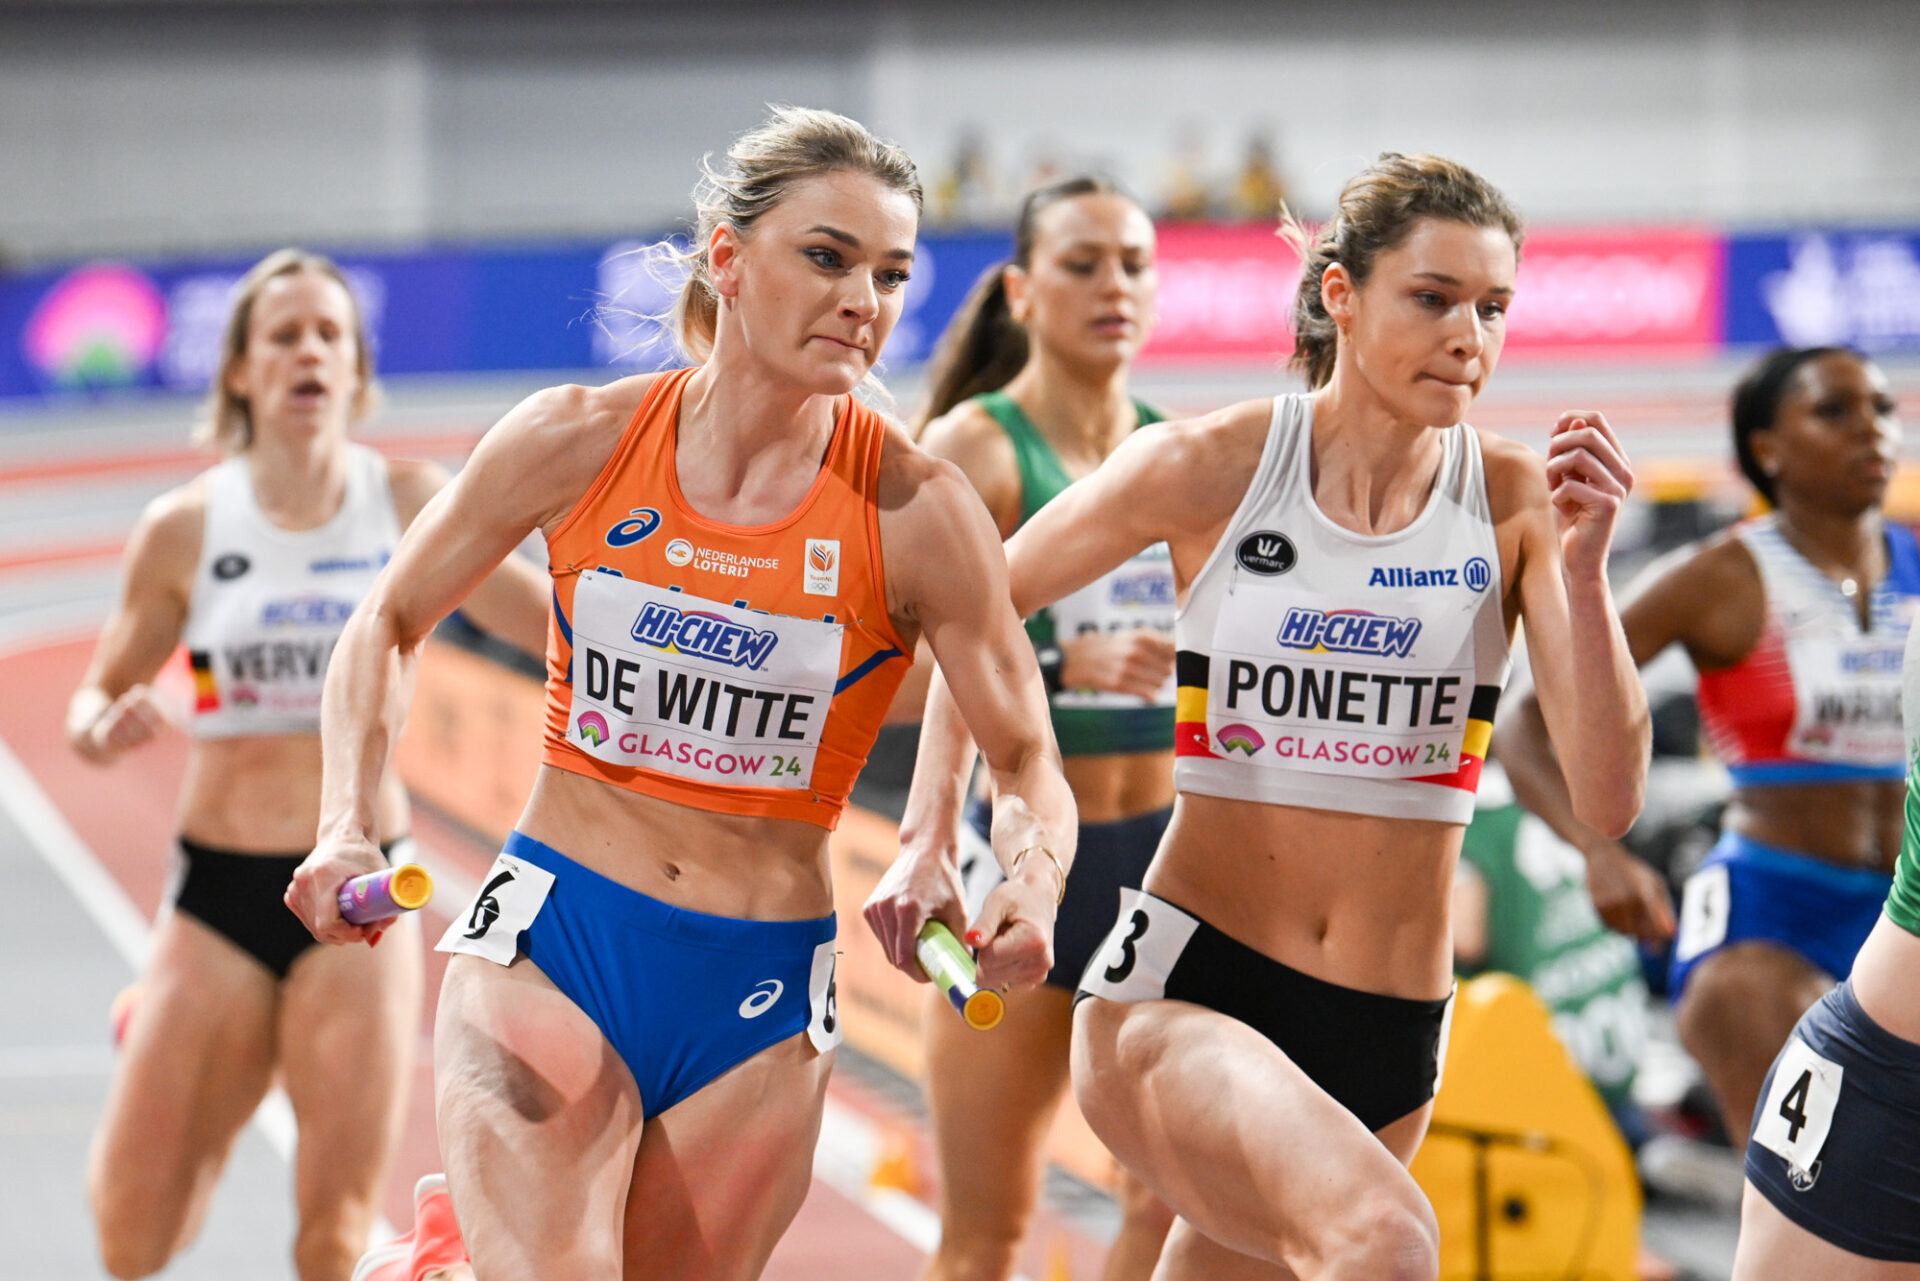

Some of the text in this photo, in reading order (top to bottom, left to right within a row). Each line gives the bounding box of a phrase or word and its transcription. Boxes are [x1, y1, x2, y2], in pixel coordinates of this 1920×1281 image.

[693, 557, 749, 578] LOTERIJ
[696, 547, 779, 570] NEDERLANDSE
[1368, 567, 1459, 588] Allianz
[632, 602, 777, 670] HI-CHEW
[1278, 607, 1422, 658] HI-CHEW
[586, 647, 815, 740] DE WITTE
[1226, 659, 1461, 728] PONETTE
[618, 732, 802, 777] GLASGOW 24
[1275, 736, 1450, 766] GLASGOW 24
[1104, 909, 1149, 983] 3
[1779, 1069, 1812, 1144] 4
